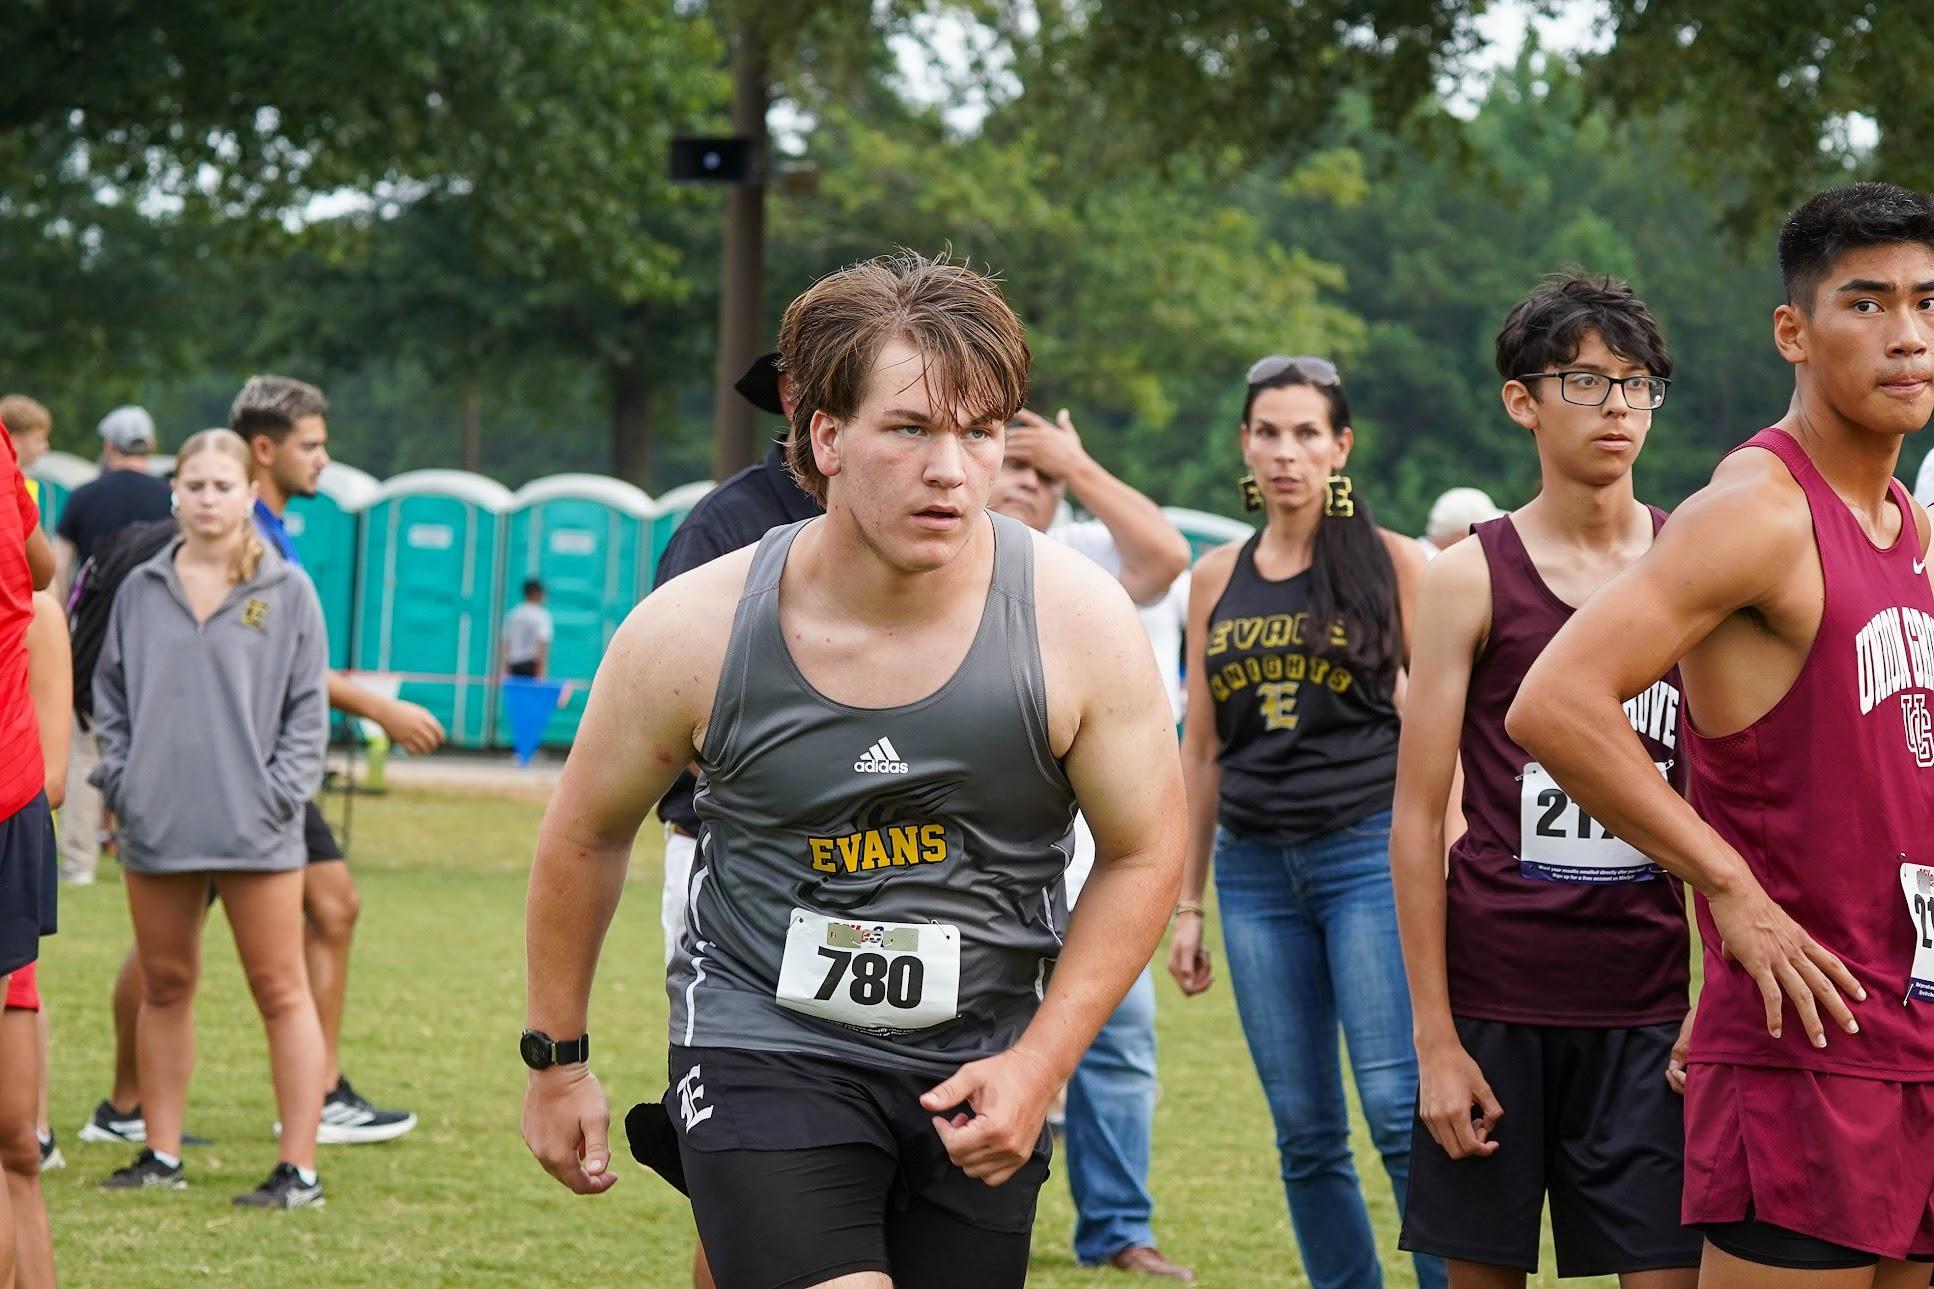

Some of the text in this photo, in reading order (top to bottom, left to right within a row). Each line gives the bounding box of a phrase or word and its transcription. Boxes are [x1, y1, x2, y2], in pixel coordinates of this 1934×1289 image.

[1210, 653, 1353, 702] KNIGHTS
[1855, 607, 1912, 716] UNION
[853, 759, 909, 774] adidas
[1536, 788, 1615, 840] 21
[807, 822, 948, 874] EVANS
[813, 946, 924, 1010] 780
